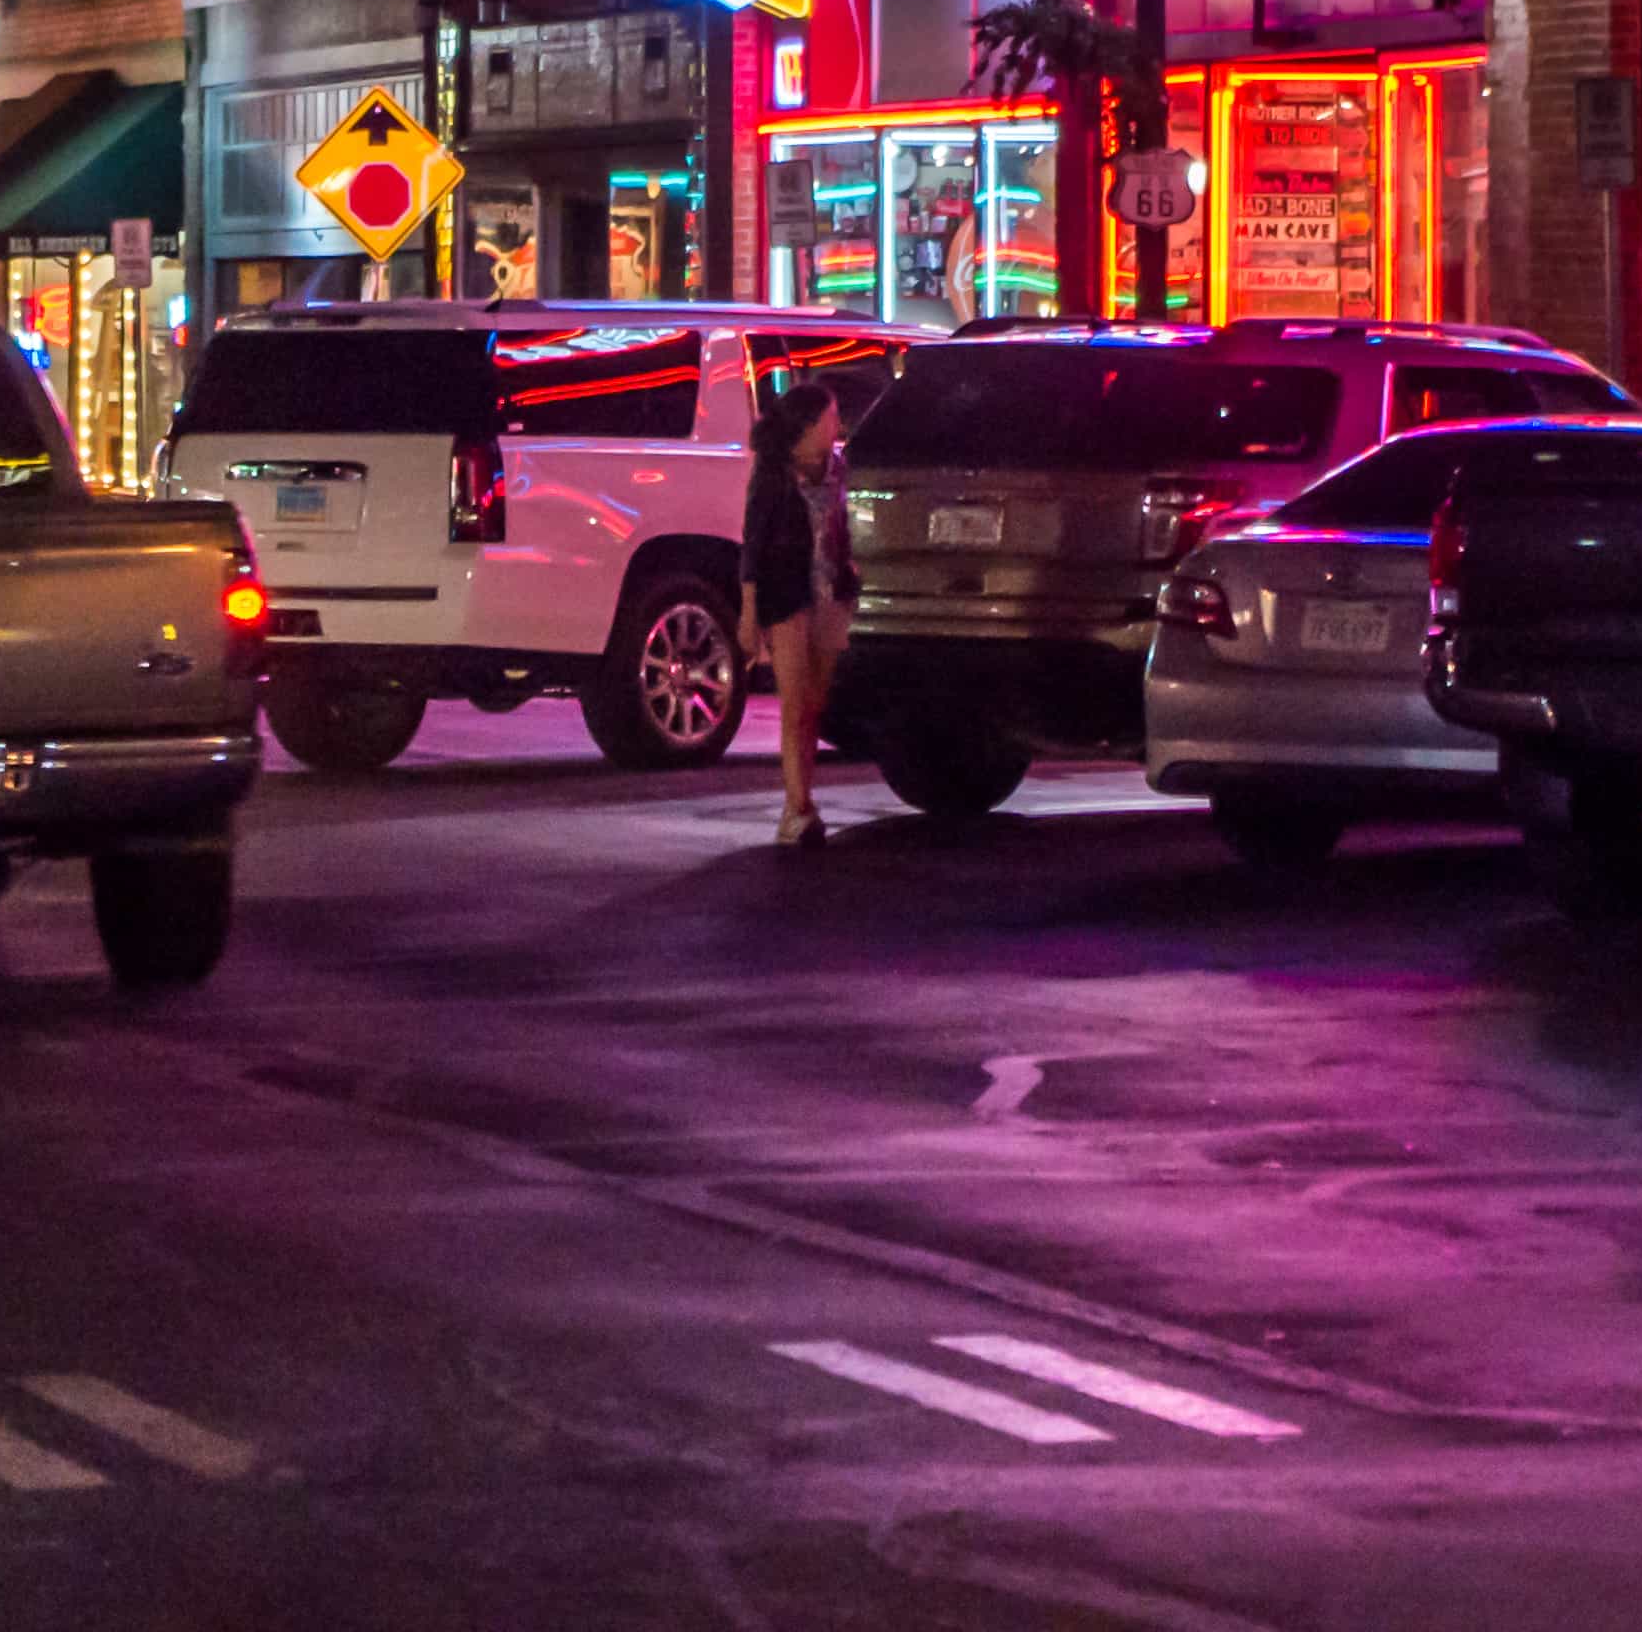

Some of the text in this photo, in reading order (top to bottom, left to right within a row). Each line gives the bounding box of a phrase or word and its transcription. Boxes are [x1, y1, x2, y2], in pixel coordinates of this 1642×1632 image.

[1136, 189, 1174, 217] 66
[1286, 197, 1334, 217] BONE
[1235, 222, 1331, 238] MAN CAVE
